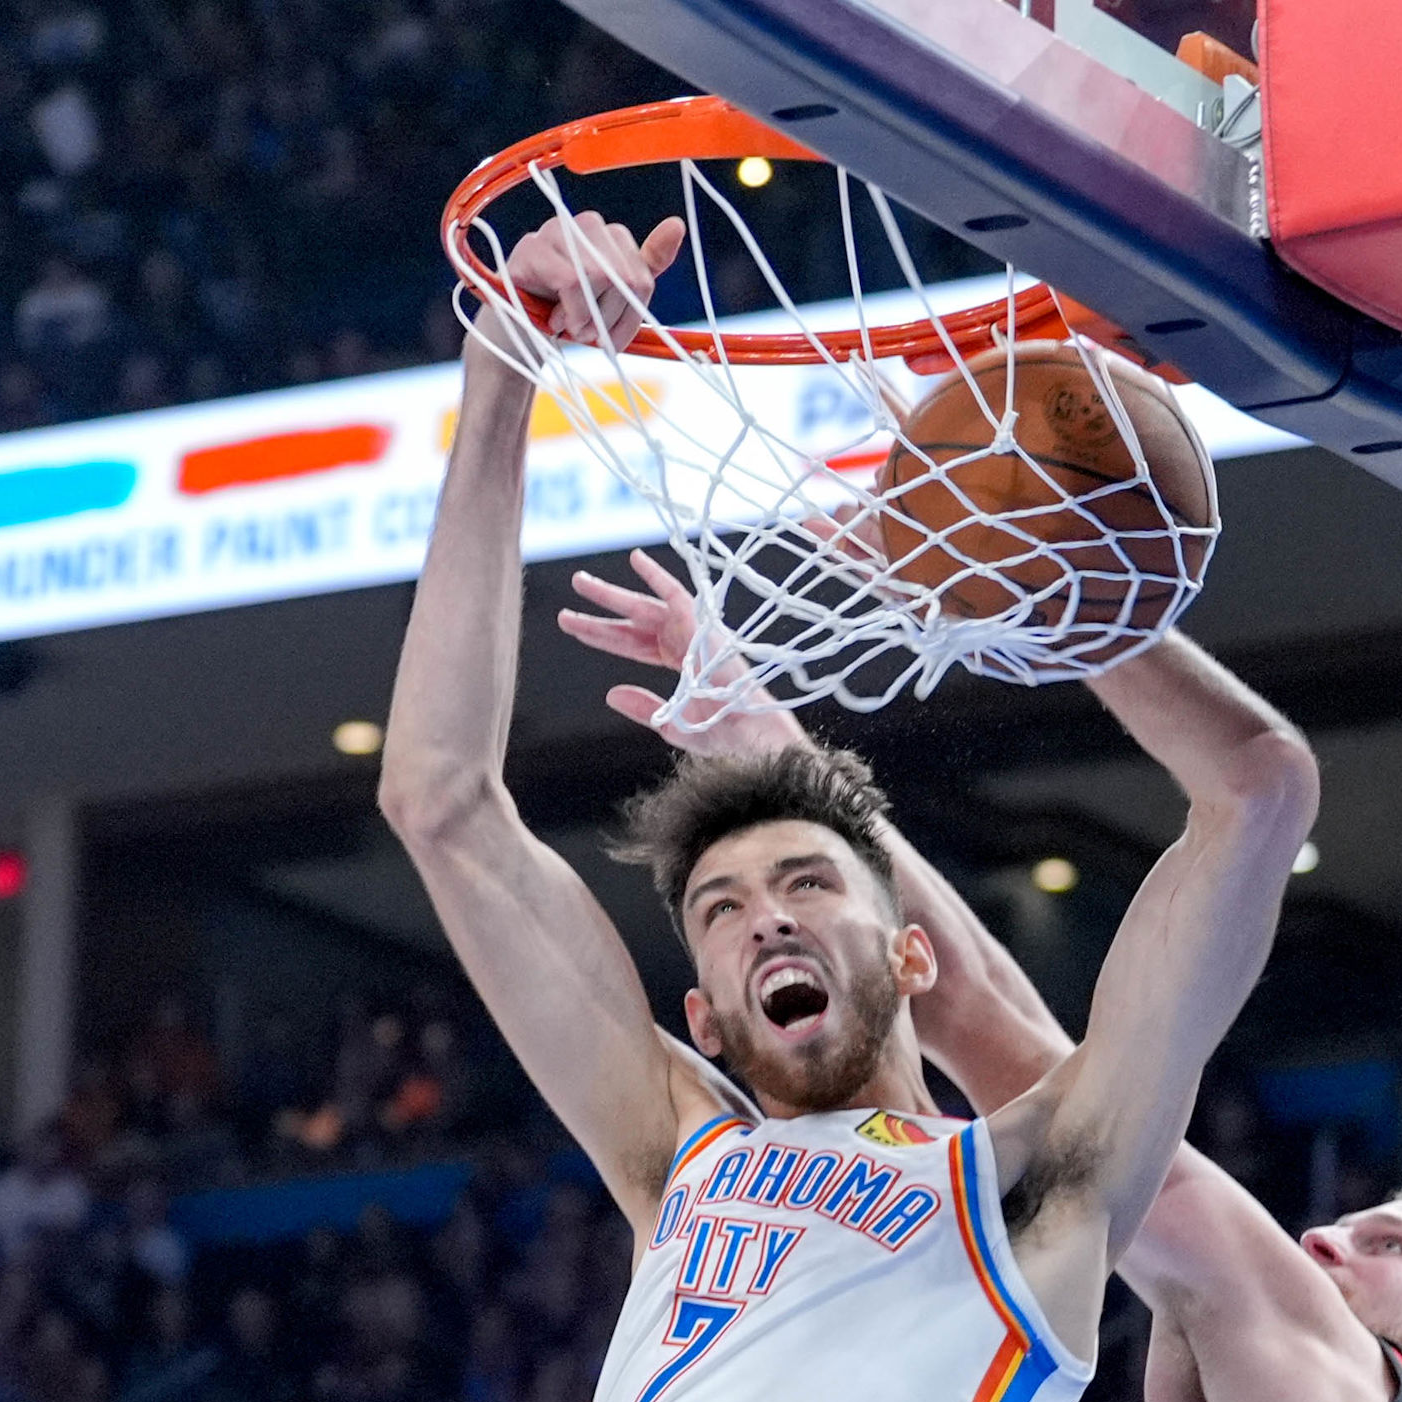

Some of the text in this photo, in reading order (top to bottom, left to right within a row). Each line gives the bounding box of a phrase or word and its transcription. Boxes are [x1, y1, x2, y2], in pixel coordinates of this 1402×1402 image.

[202, 500, 350, 568] PAINT
[650, 1143, 941, 1252] OAHOMA
[676, 1214, 808, 1295] ITY
